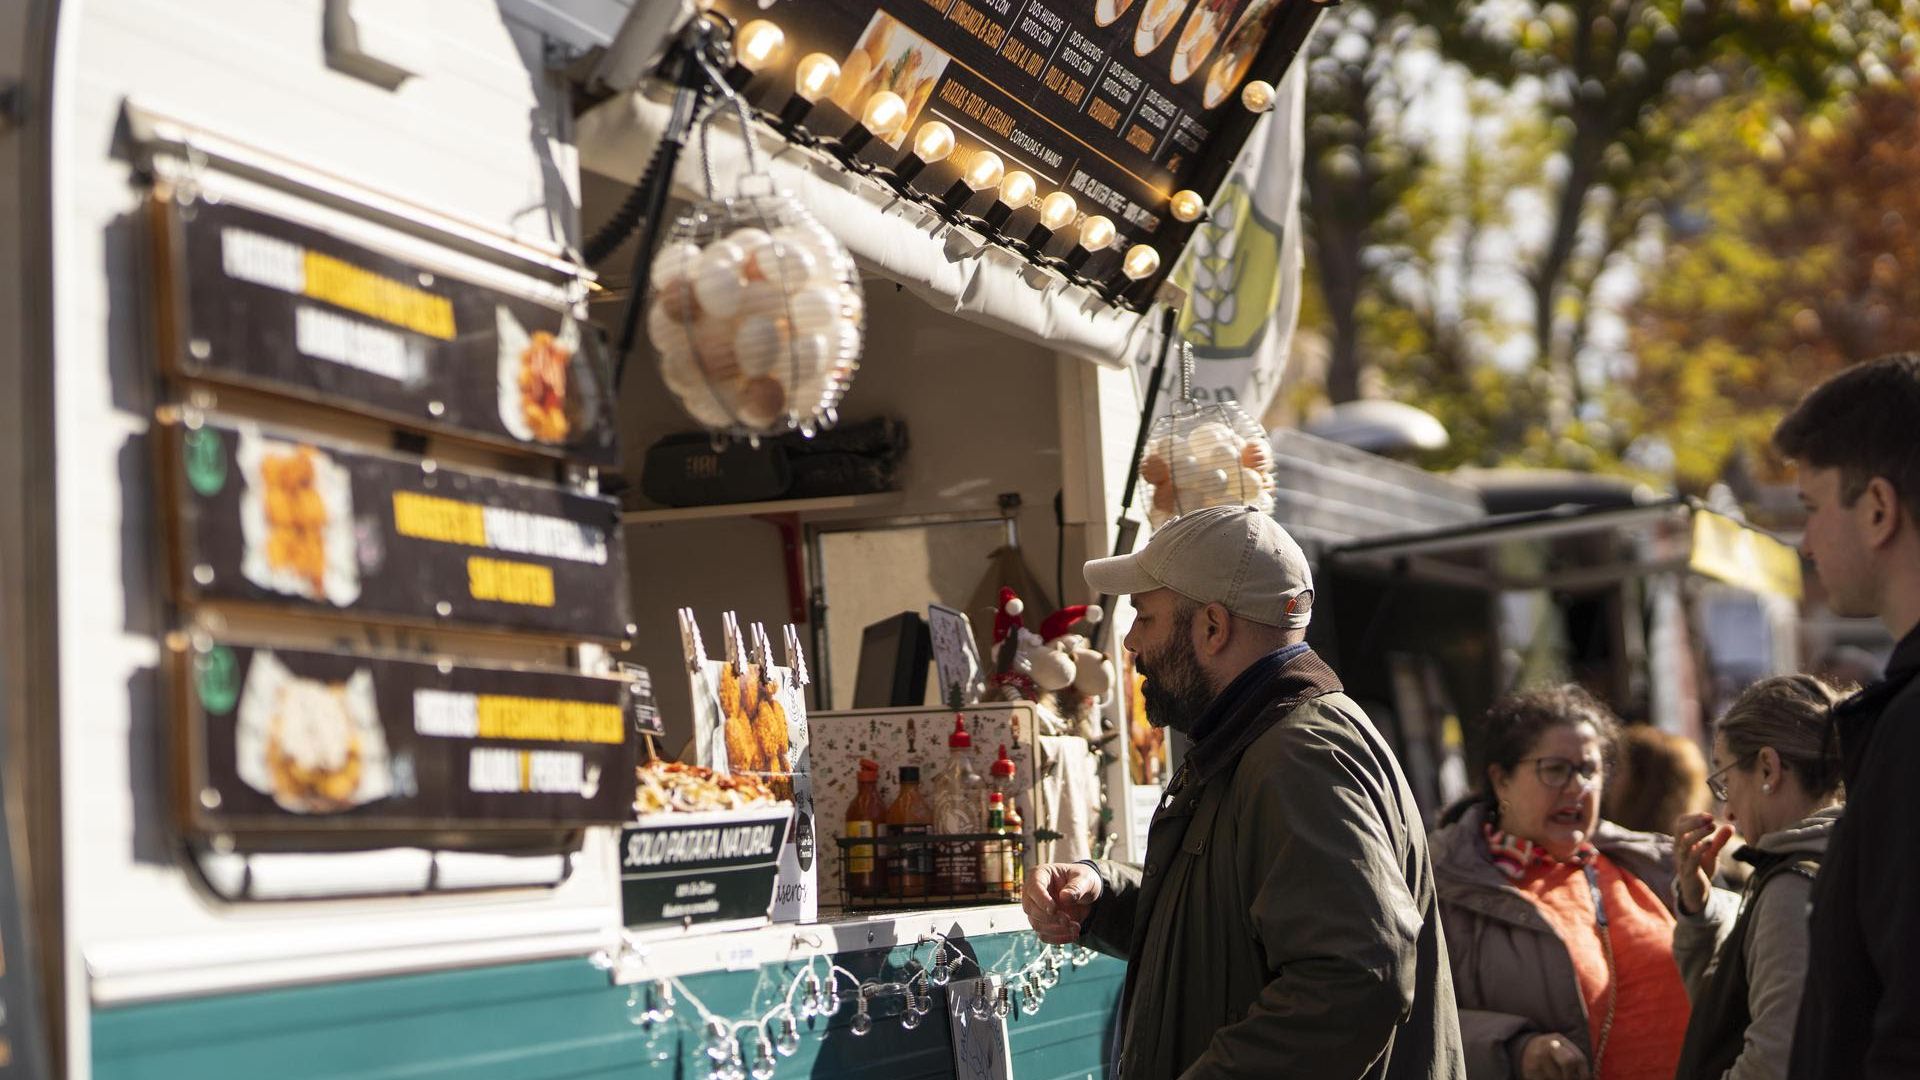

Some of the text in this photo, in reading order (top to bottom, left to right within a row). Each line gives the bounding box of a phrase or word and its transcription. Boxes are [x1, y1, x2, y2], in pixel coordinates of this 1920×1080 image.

[1028, 0, 1064, 33] DOS HUEVOS
[1021, 17, 1054, 48] ROTOS CON
[1069, 31, 1104, 62] DOS HUEVOS
[1062, 47, 1094, 77] ROTOS CON
[1043, 65, 1064, 91] POLLO
[939, 78, 968, 111] PATATAS
[962, 93, 987, 120] FRITAS
[980, 102, 1017, 138] ARTESANAS
[1009, 129, 1041, 157] CORTADAS
[1042, 151, 1063, 169] MANO
[624, 824, 775, 866] SOLO PATATA NATURAL
